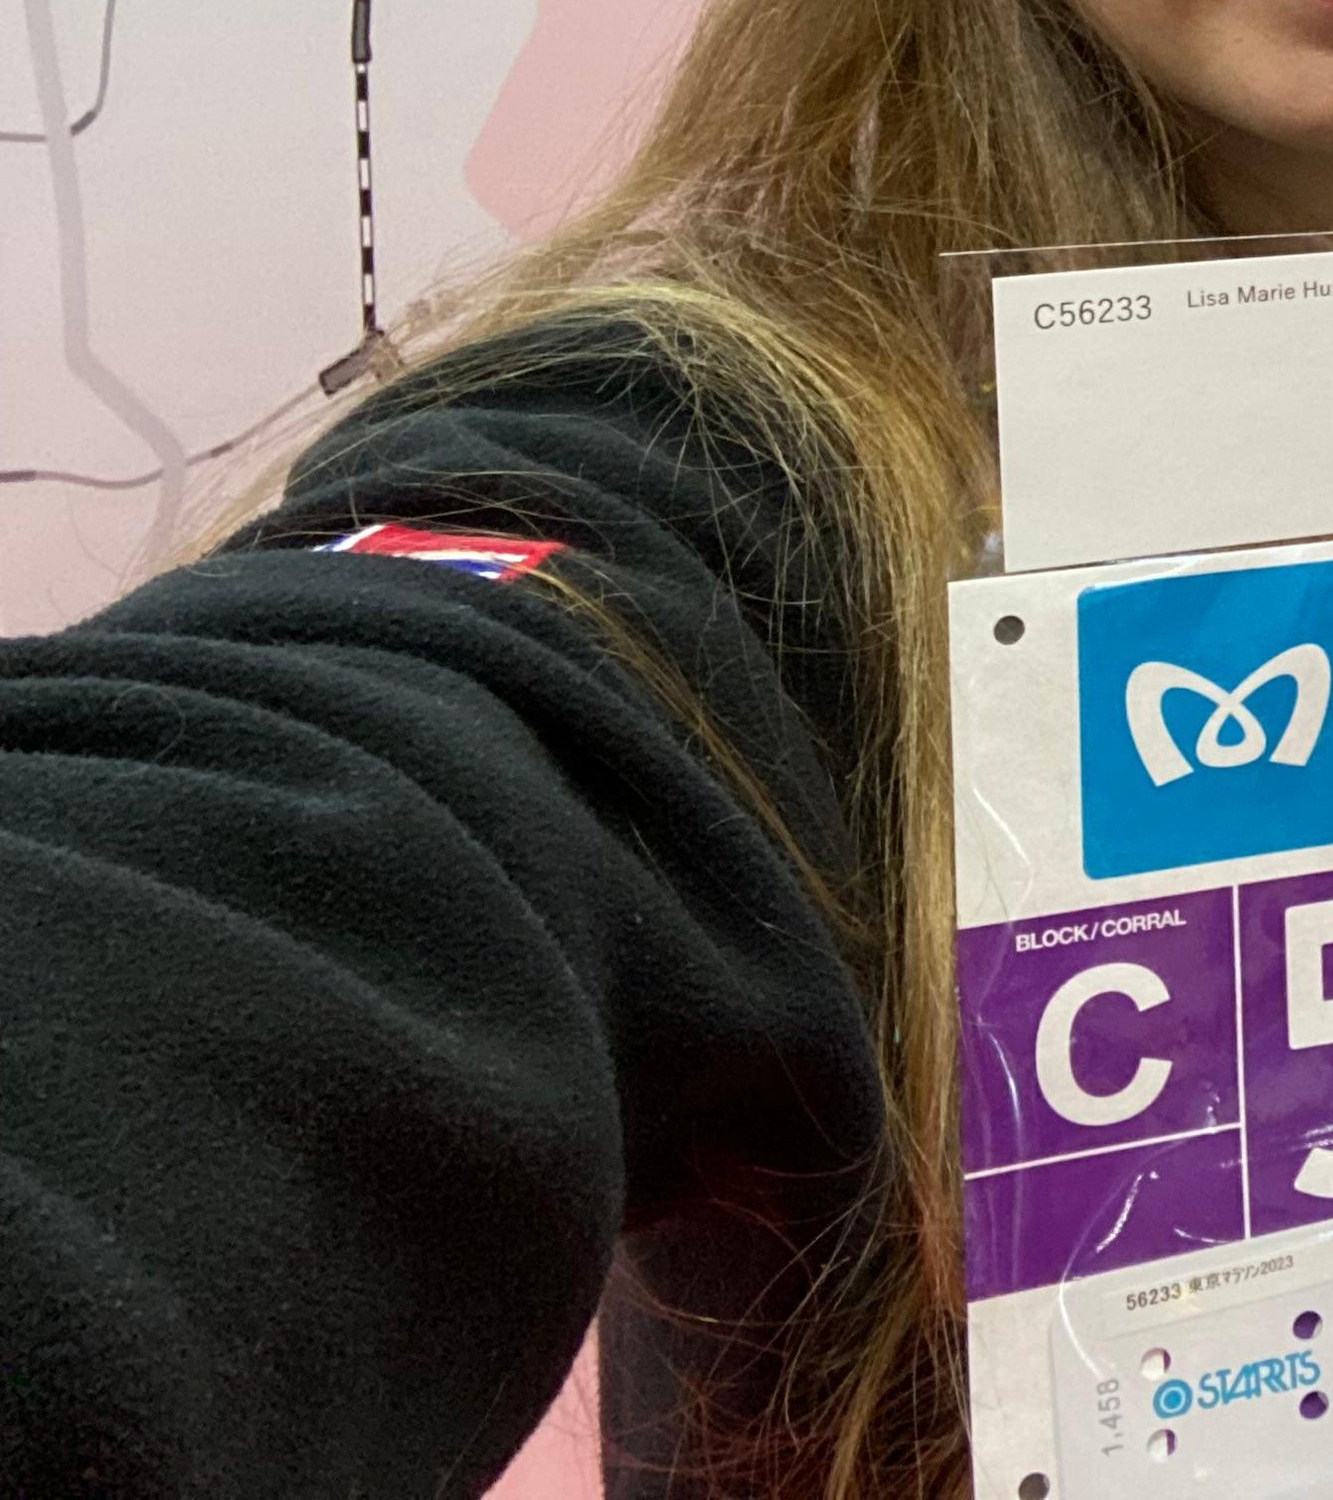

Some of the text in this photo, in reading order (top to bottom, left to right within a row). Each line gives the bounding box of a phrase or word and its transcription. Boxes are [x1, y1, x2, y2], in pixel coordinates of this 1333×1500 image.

[1034, 294, 1152, 329] C56233
[1187, 287, 1229, 309] Lisa
[1237, 282, 1295, 304] Marie
[1036, 961, 1173, 1126] C
[1127, 1255, 1294, 1311] 56233 東京マラソン2023
[1197, 1349, 1321, 1410] STARTS
